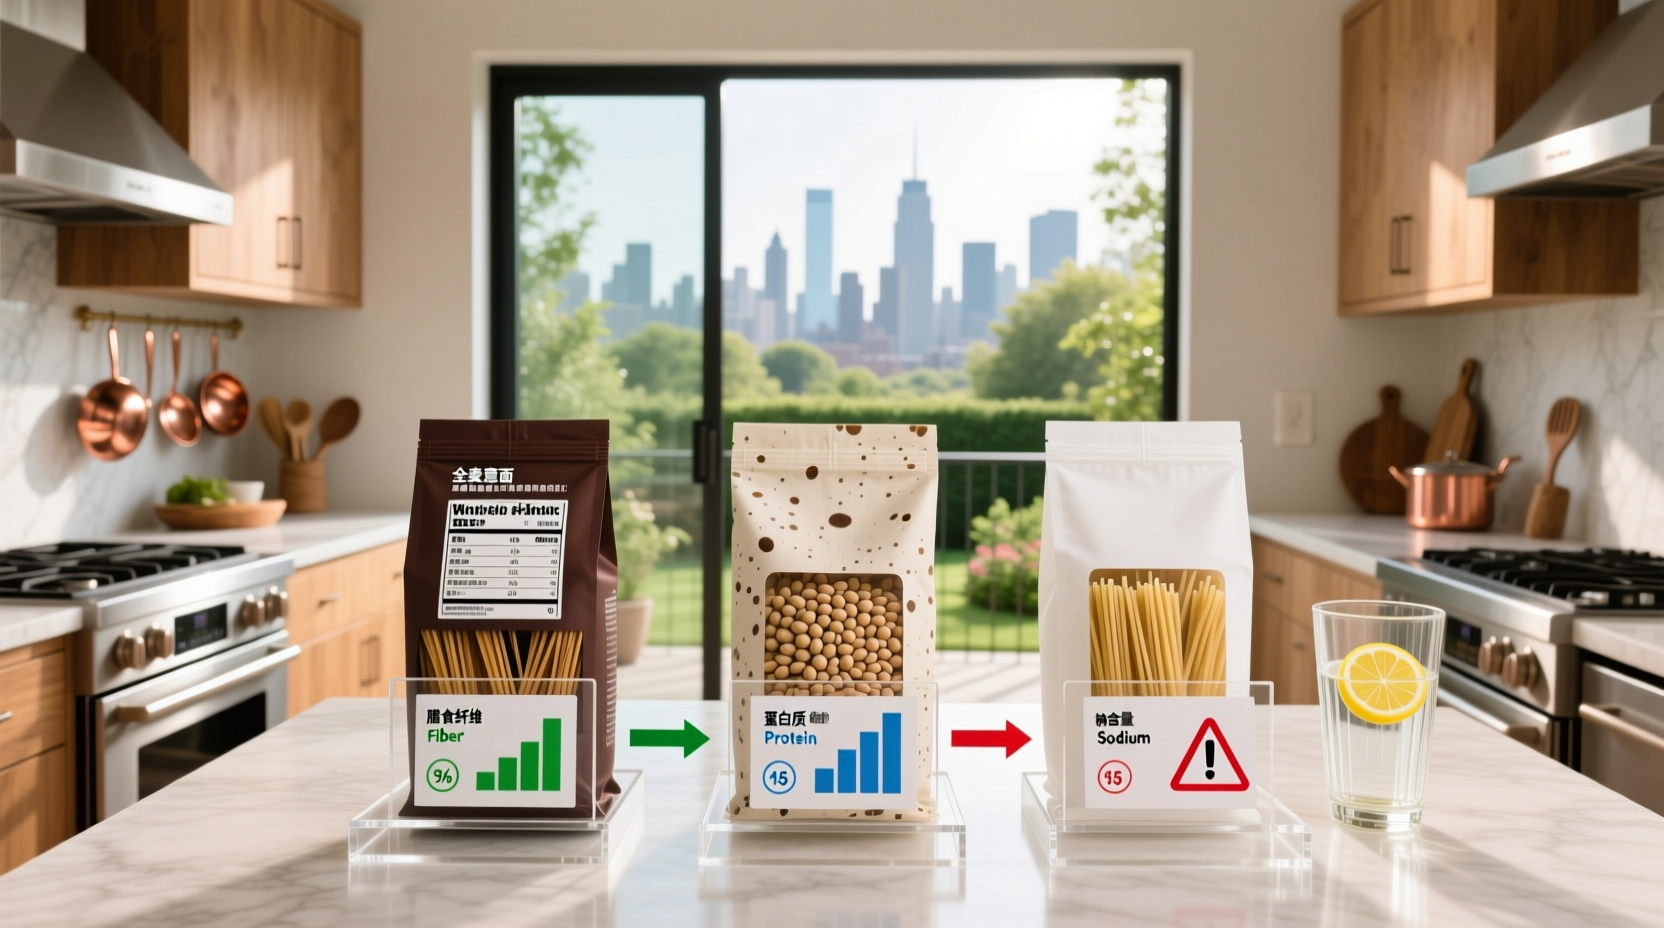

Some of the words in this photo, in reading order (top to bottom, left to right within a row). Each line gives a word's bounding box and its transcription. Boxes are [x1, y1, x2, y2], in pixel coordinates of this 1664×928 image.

[427, 727, 465, 743] Fiber
[764, 730, 817, 745] Protein
[1097, 730, 1151, 745] Sodium
